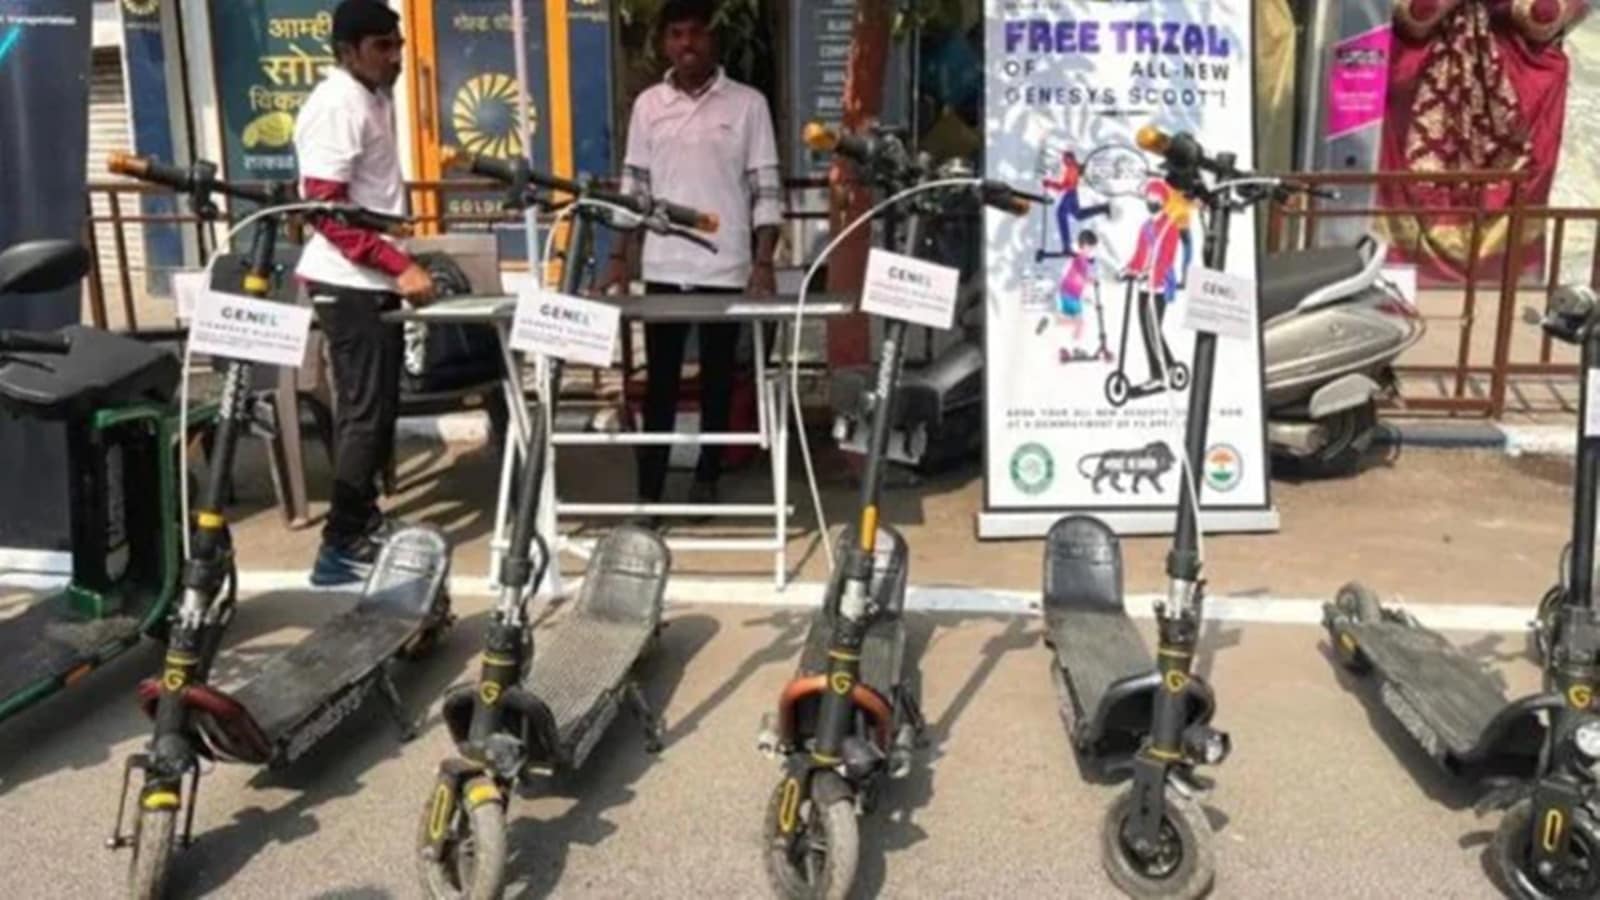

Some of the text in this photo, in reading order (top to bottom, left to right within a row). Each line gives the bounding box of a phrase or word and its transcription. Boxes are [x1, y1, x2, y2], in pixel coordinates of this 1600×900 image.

[1004, 20, 1230, 58] FREE TRIAL
[1004, 60, 1035, 77] OF
[1005, 86, 1116, 105] GENESYS
[221, 306, 280, 327] GENEL
